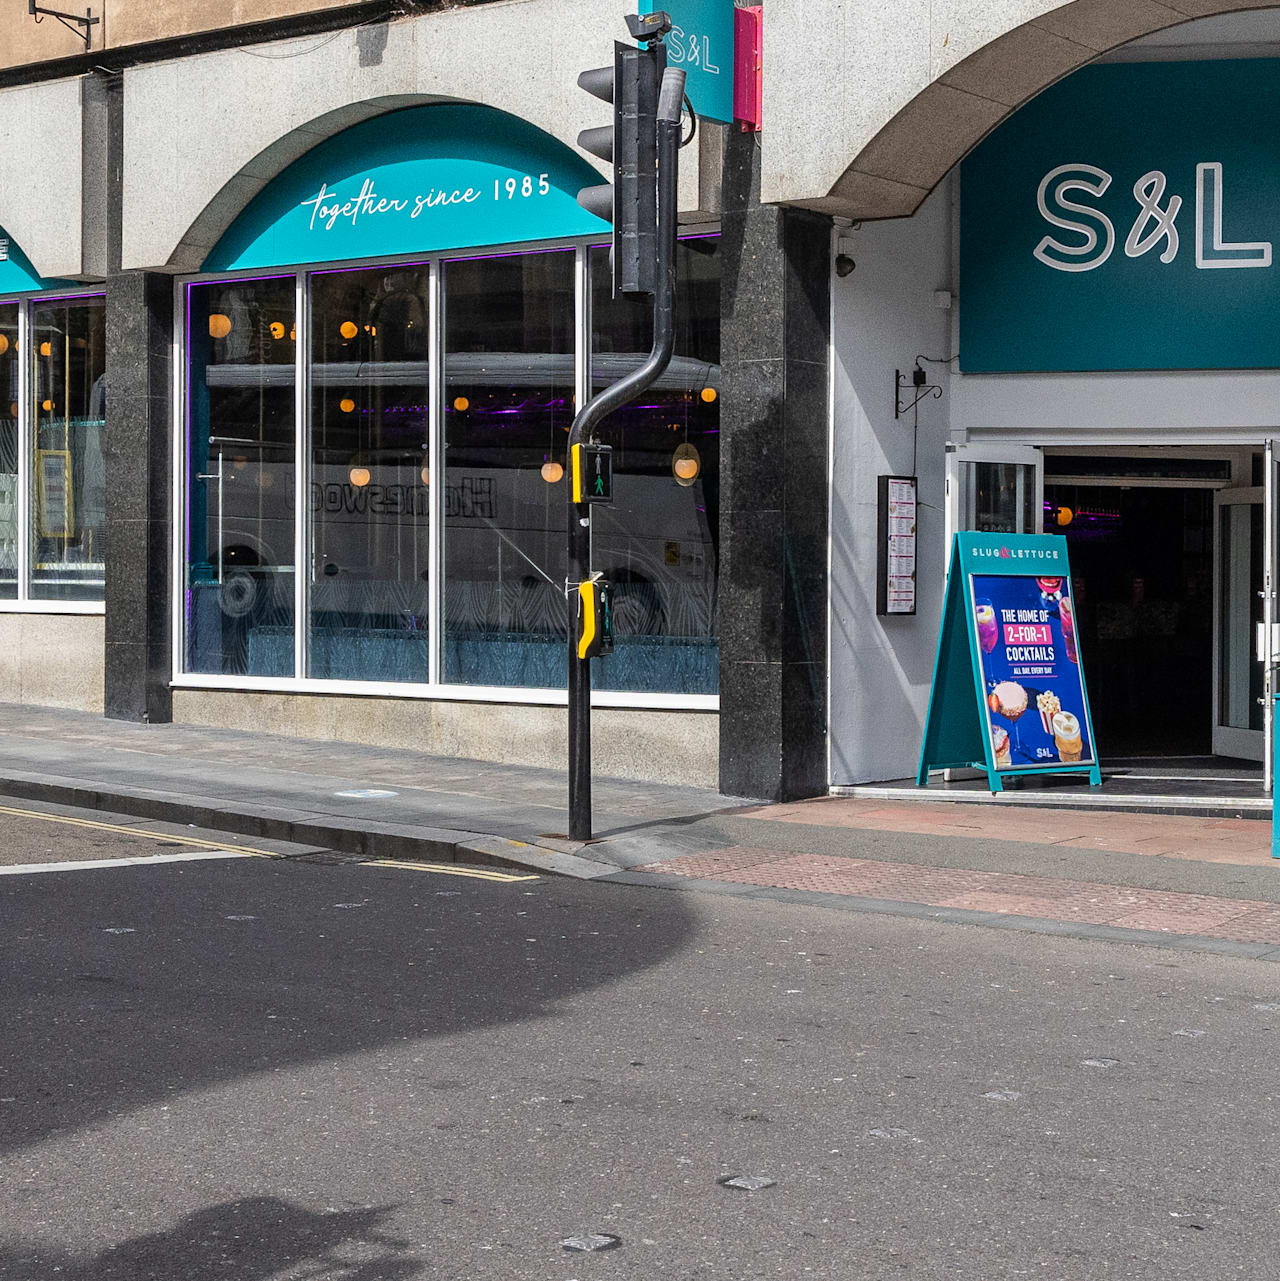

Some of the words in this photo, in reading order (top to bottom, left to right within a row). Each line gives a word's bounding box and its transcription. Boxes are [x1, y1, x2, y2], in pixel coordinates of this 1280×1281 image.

[667, 25, 720, 75] S&L
[301, 178, 409, 231] together
[410, 187, 482, 219] since
[494, 173, 550, 201] 1985
[1033, 161, 1273, 273] S&L
[1001, 609, 1017, 623] THE
[1018, 609, 1039, 622] HOME
[1040, 609, 1049, 622] OF
[1007, 626, 1048, 642] 2-FOR-1
[1006, 646, 1055, 661] COCKTAILS
[1036, 747, 1053, 758] S&L
